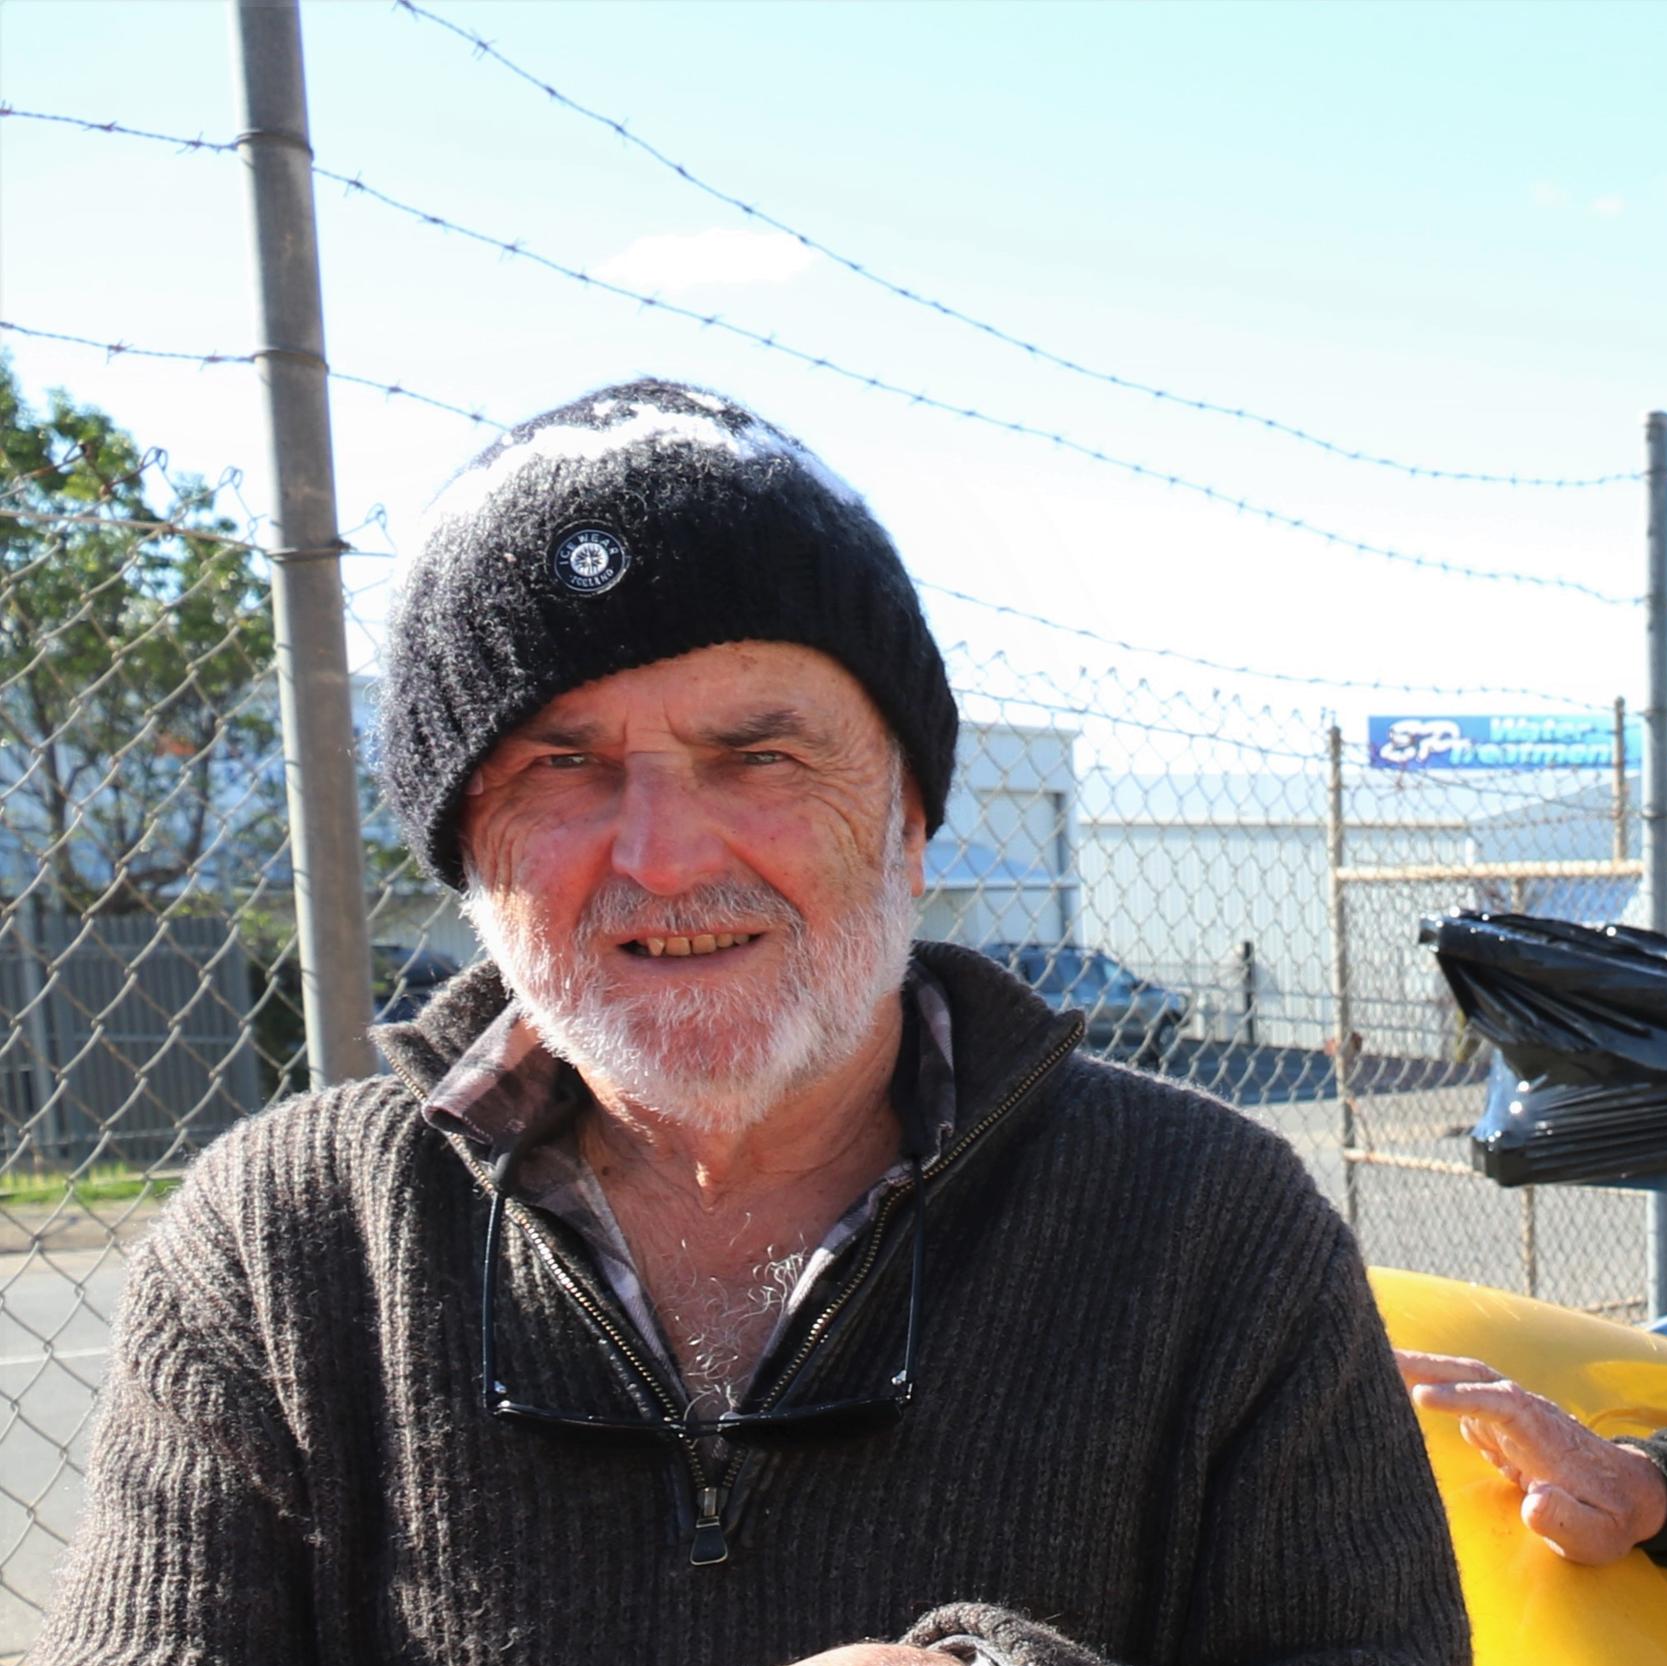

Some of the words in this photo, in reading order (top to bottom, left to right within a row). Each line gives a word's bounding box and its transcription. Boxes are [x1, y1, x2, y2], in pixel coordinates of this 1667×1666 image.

[559, 542, 577, 564] ICE
[578, 533, 619, 555] WEAR
[570, 568, 614, 587] ICELAND
[1489, 716, 1594, 743] Water
[1449, 738, 1615, 765] Treatmen
